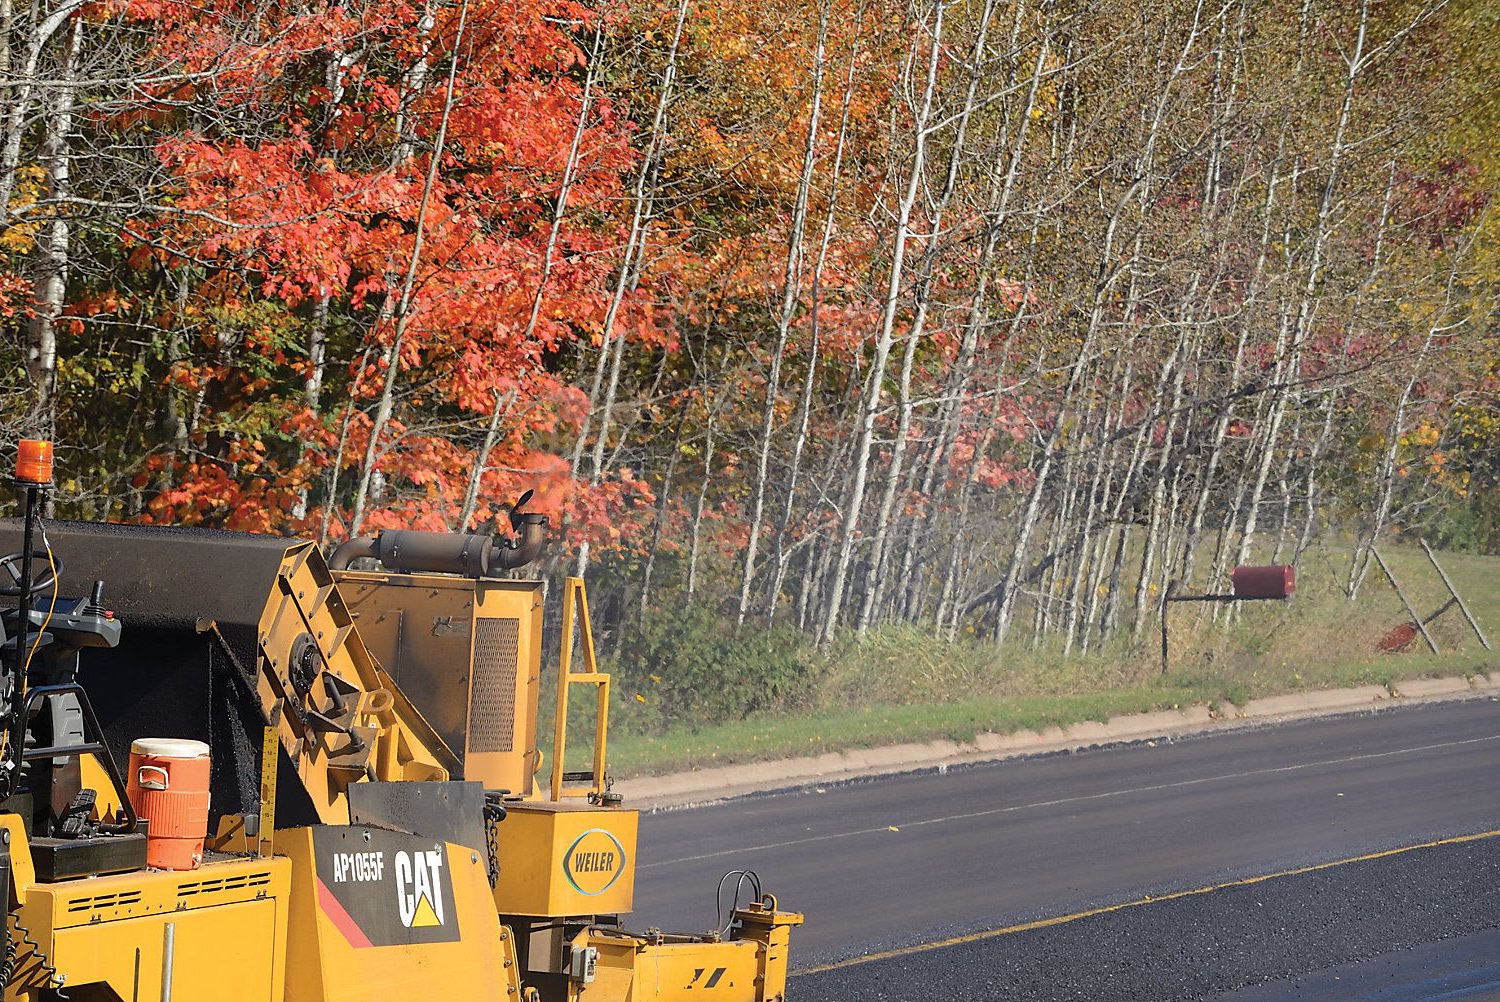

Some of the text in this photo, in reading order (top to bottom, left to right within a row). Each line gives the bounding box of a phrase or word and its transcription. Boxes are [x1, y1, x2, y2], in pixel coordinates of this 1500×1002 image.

[333, 851, 384, 882] AP1055F
[575, 852, 614, 872] WEILER
[395, 850, 444, 927] CAT
